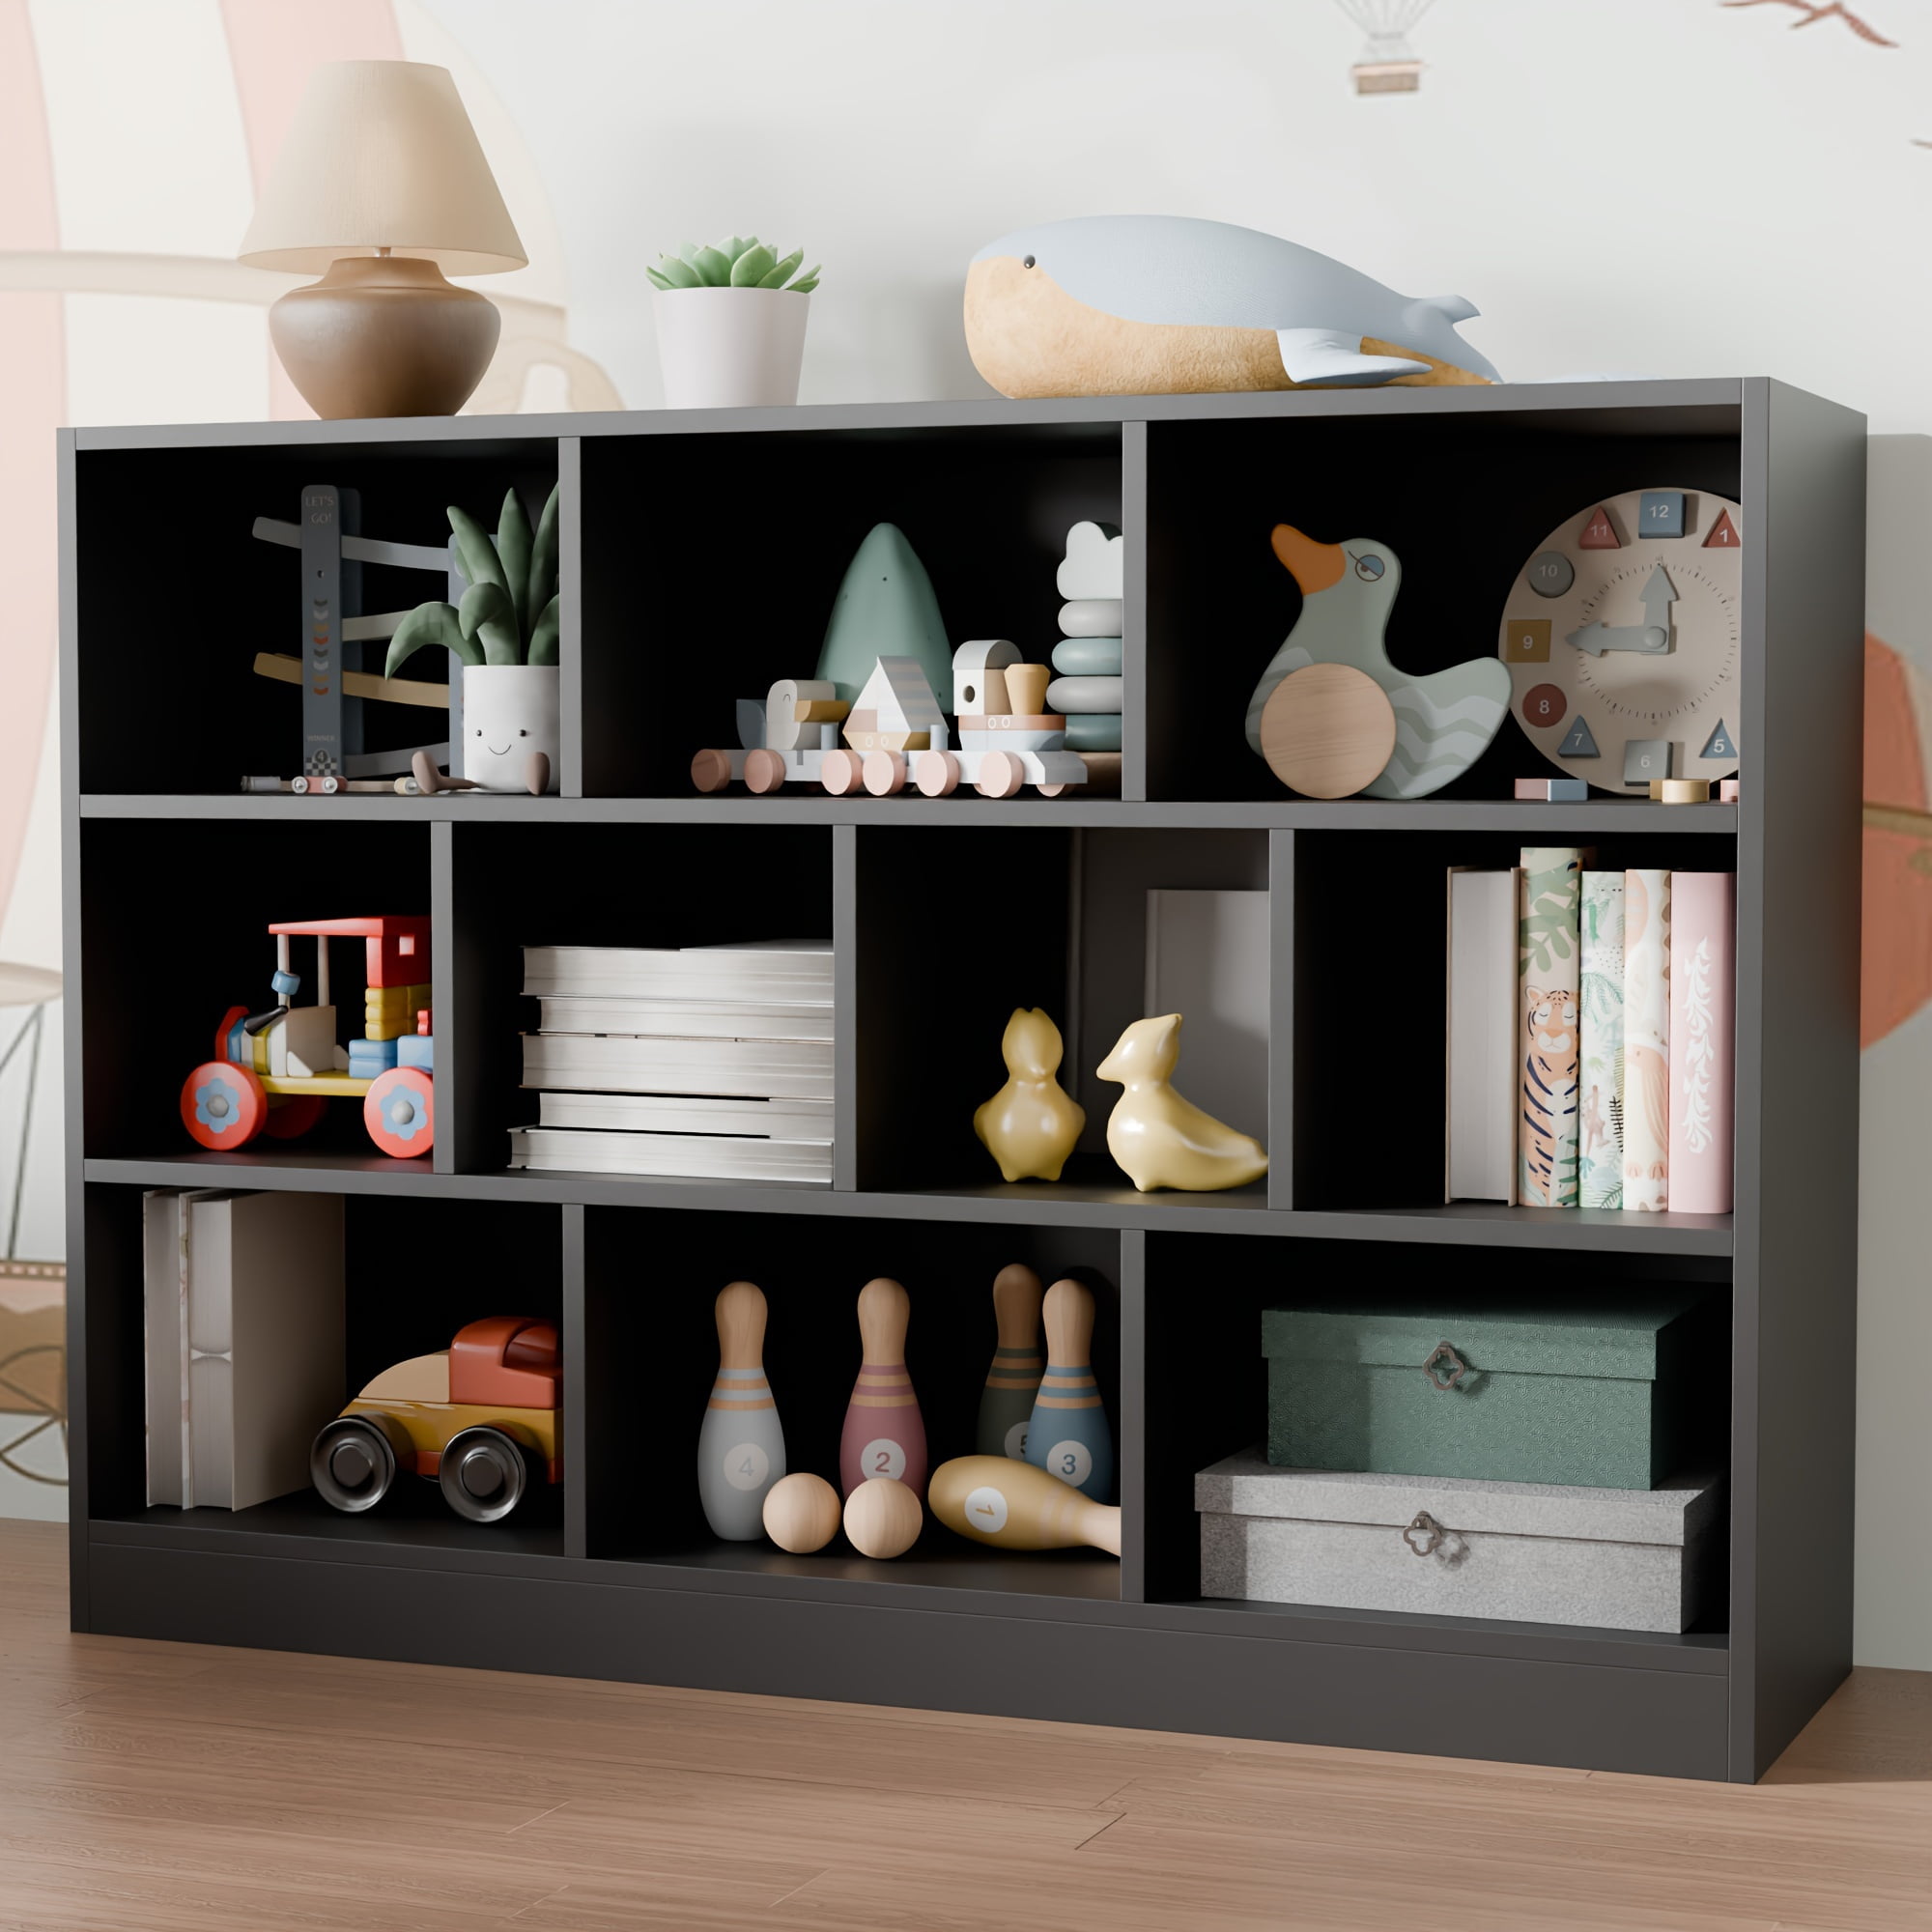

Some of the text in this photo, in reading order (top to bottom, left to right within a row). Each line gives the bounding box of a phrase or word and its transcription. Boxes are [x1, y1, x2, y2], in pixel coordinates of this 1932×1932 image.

[305, 495, 334, 507] LET'S
[311, 512, 332, 524] GO!
[1649, 504, 1669, 518] 12
[1590, 525, 1608, 537] 11
[1719, 528, 1728, 543] 1
[1538, 564, 1558, 578] 10
[1522, 636, 1533, 650] 9
[1539, 699, 1550, 714] 8
[1574, 733, 1583, 747] 7
[1713, 739, 1725, 753] 5
[317, 751, 326, 762] 4
[1640, 755, 1651, 768] 6
[738, 1456, 754, 1477] 4
[874, 1451, 891, 1473] 2
[1062, 1454, 1076, 1475] 3
[975, 1503, 996, 1517] 1
